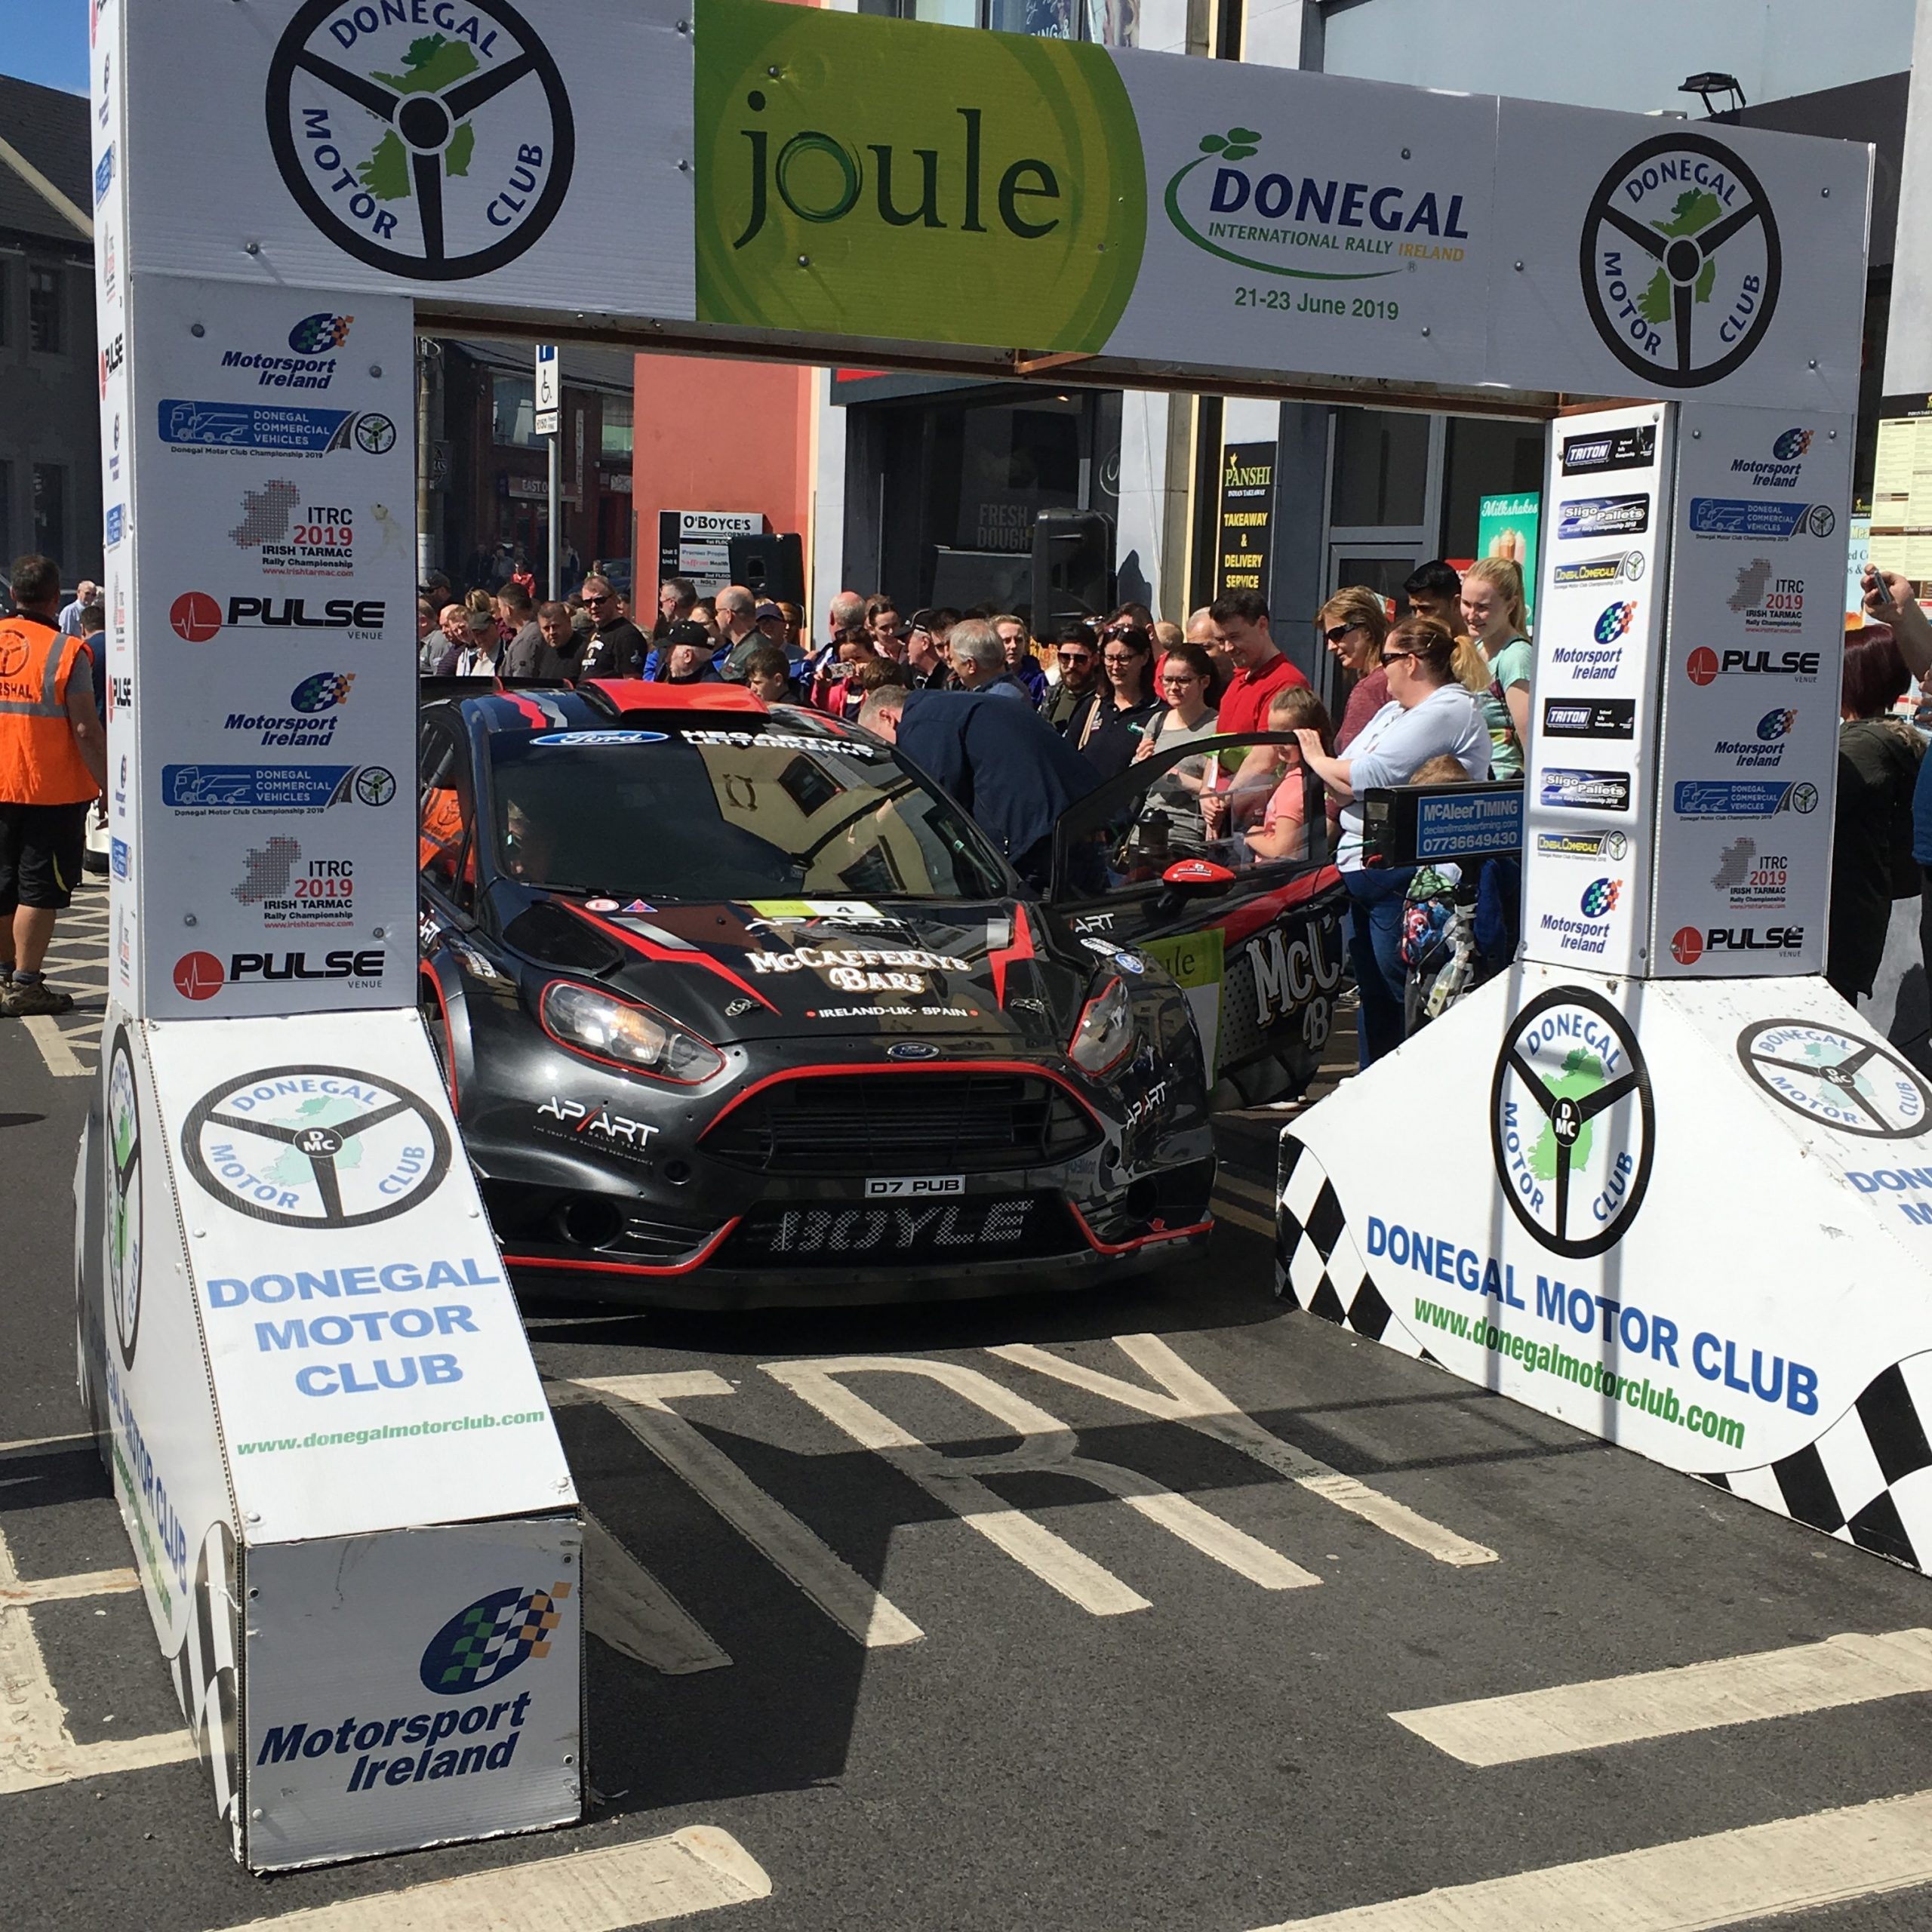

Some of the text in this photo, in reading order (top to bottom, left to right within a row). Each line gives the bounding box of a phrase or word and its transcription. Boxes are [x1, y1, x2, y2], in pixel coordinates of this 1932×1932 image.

[330, 0, 500, 58] DONEGAL
[301, 109, 398, 240] MOTOR
[733, 90, 1060, 250] joule
[487, 143, 543, 227] CLUB
[1625, 159, 1737, 207] DONEGAL
[1210, 168, 1469, 239] DONEGAL
[1208, 222, 1465, 262] INTERNATIONAL RALLY IRELAND
[1235, 287, 1399, 321] 21-23 June 2019
[1604, 251, 1662, 356] MOTOR
[1719, 274, 1761, 343] CLUB
[221, 351, 337, 374] Motorsport
[259, 371, 332, 389] Ireland
[254, 411, 309, 423] DONEGAL
[254, 423, 330, 435] COMMERCIAL
[254, 433, 309, 445] VEHICLES
[171, 446, 204, 455] Donegal
[205, 447, 229, 455] Motor
[230, 448, 248, 456] Club
[250, 449, 303, 459] Championship
[1570, 444, 1608, 461] TRITON
[1730, 459, 1801, 475] Motorsport
[1225, 466, 1271, 487] PANSHI
[1752, 474, 1798, 487] Ireland
[308, 506, 352, 525] ITRC
[980, 503, 1028, 528] FRESH
[1481, 499, 1538, 517] Milkshakes
[1565, 506, 1645, 521] Sligo Pallets
[1747, 505, 1783, 514] DONEGAL
[684, 515, 751, 531] O'BOYCE'S
[1224, 512, 1268, 527] TAKEAWAY
[1746, 523, 1781, 531] VEHICLES
[1747, 514, 1795, 523] COMMERCIAL
[294, 525, 352, 546] 2019
[977, 526, 1029, 550] DOUGH
[1241, 534, 1247, 547] &
[263, 546, 352, 558] IRISH TARMAC
[1225, 554, 1263, 568] DELIVERY
[263, 557, 353, 568] Rally Championship
[263, 568, 354, 577] www.irishtarmac.com
[1226, 575, 1259, 588] SERVICE
[1776, 580, 1804, 593] ITRC
[1766, 594, 1803, 610] 2019
[227, 596, 386, 628] PULSE
[1746, 609, 1802, 619] IRISH TARMAC
[1761, 620, 1801, 628] Championship
[348, 631, 383, 640] VENUE
[1552, 648, 1623, 664] Motorsport
[1721, 650, 1820, 674] PULSE
[1572, 664, 1618, 679] Ireland
[224, 714, 337, 732] Motorsport
[1550, 711, 1588, 723] TRITON
[261, 731, 334, 746] Ireland
[1715, 742, 1785, 755] Motorsport
[1737, 755, 1782, 767] Ireland
[256, 770, 311, 780] DONEGAL
[256, 781, 331, 791] COMMERCIAL
[1546, 774, 1626, 798] Sligo Pallets
[256, 792, 310, 801] VEHICLES
[174, 808, 206, 817] Donegal
[252, 808, 305, 816] Championship
[1423, 832, 1517, 852] 07736649430
[309, 860, 352, 878] ITRC
[1760, 857, 1788, 869] ITRC
[1749, 871, 1786, 885] 2019
[294, 878, 353, 898] 2019
[264, 899, 352, 909] IRISH TARMAC
[264, 910, 353, 920] Rally Championship
[264, 920, 354, 928] www.irishtarmac.com
[1540, 914, 1610, 937] Motorsport
[1561, 934, 1606, 953] Ireland
[1706, 927, 1804, 950] PULSE
[230, 950, 385, 981] PULSE
[348, 980, 383, 989] VENUE
[923, 1008, 968, 1017] SPAIN
[1524, 1013, 1622, 1074] DONEGAL
[1758, 1029, 1851, 1053] DONEGAL
[1829, 1075, 1853, 1084] MC
[230, 1078, 377, 1112] DONEGAL
[1770, 1076, 1859, 1124] MOTOR
[1895, 1081, 1919, 1116] CLUB
[1555, 1118, 1576, 1137] MC
[303, 1140, 337, 1152] MC
[588, 1131, 645, 1152] RALLY TEAM
[1503, 1101, 1545, 1214] MOTOR
[210, 1144, 300, 1209] MOTOR
[379, 1146, 426, 1195] CLUB
[870, 1180, 961, 1193] D7 PUB
[1592, 1150, 1634, 1221] CLUB
[770, 1200, 1034, 1251] BOYLE
[207, 1258, 500, 1309] DONEGAL
[1367, 1216, 1820, 1417] DONEGAL MOTOR CLUB
[254, 1305, 481, 1352] MOTOR
[295, 1353, 463, 1397] CLUB
[1414, 1296, 1746, 1449] www.donegalmotorclub.com
[237, 1411, 545, 1456] www.donegalmotorclub.com
[155, 1475, 187, 1596] CLUB
[256, 1690, 532, 1766] Motorsport
[346, 1730, 520, 1793] Ireland
